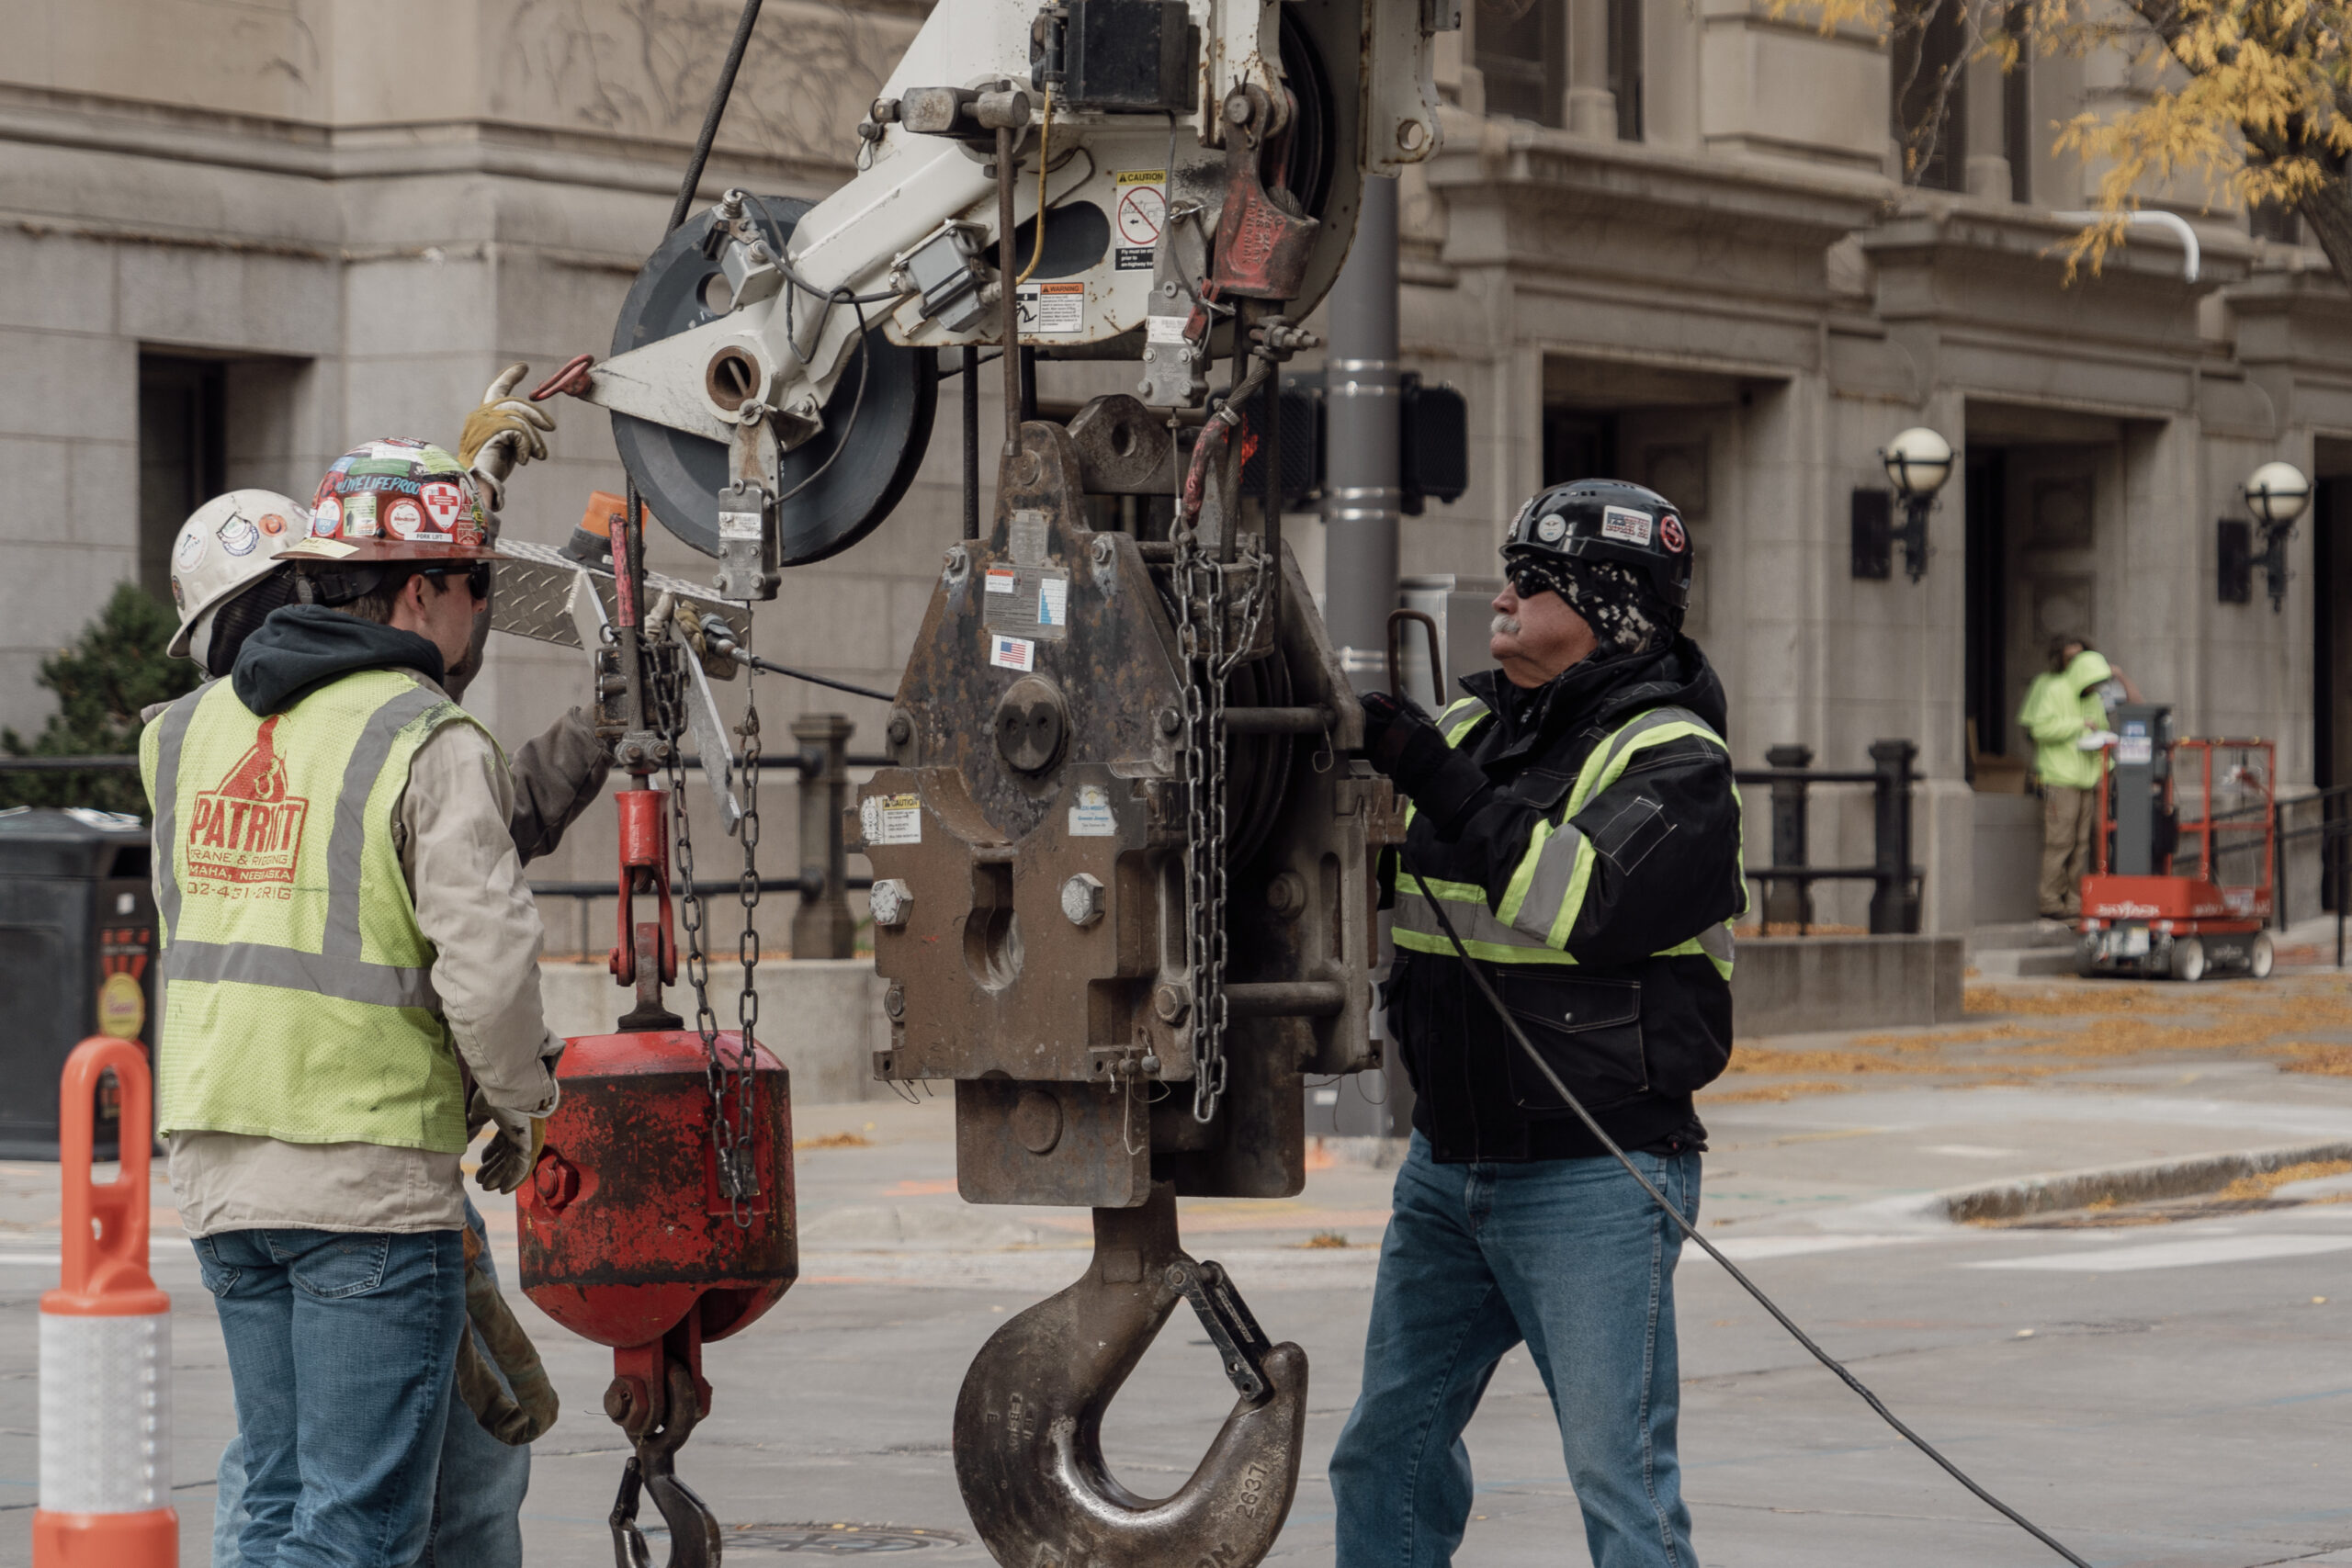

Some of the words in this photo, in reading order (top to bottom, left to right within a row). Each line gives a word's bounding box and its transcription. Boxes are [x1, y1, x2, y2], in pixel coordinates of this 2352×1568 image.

[1127, 173, 1163, 182] CAUTION
[335, 475, 422, 495] #LIVELIFEPROO
[190, 849, 232, 863] RANE
[237, 854, 248, 865] &
[189, 864, 232, 880] MAHA,
[1235, 1463, 1268, 1520] 2637
